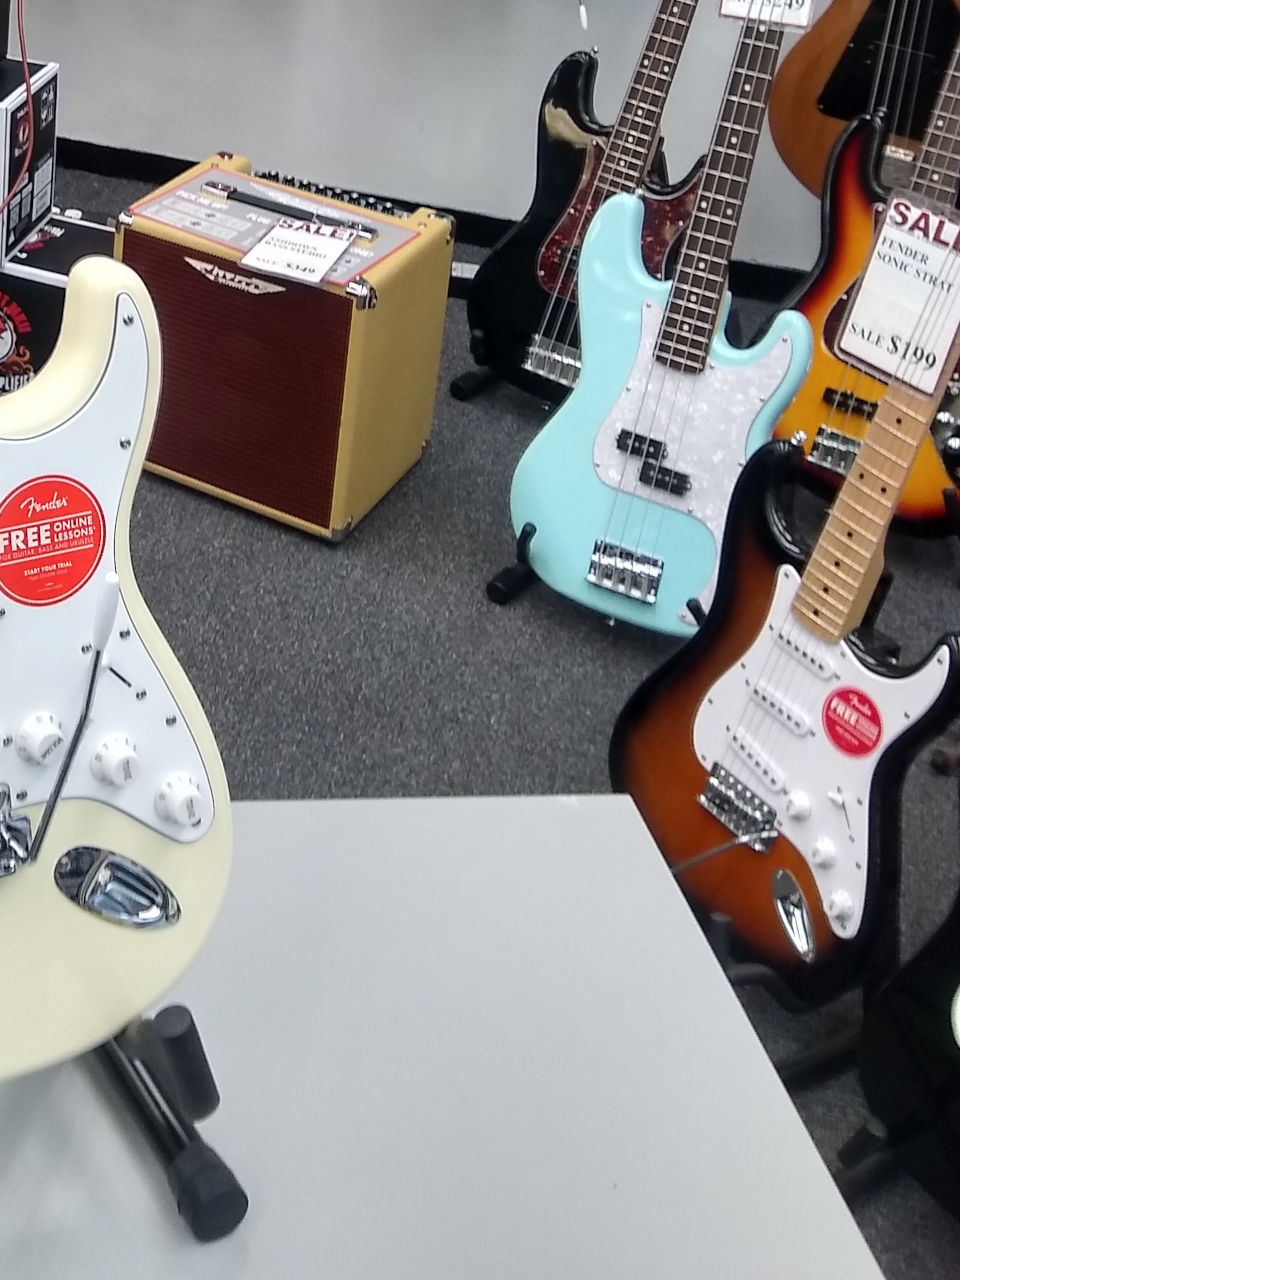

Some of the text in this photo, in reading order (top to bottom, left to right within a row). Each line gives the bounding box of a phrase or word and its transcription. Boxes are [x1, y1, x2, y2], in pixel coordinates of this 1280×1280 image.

[278, 218, 355, 242] SALE!
[880, 234, 930, 266] FENDER
[875, 252, 953, 295] SONIC STRAT
[848, 321, 938, 372] SALE $199
[20, 491, 67, 518] Fender
[53, 514, 93, 533] ONLINE
[53, 526, 94, 543] LESSONS
[37, 544, 54, 555] BASS
[54, 541, 69, 551] AND
[69, 536, 95, 548] UKULELE
[24, 567, 41, 577] START
[40, 563, 57, 572] YOUR
[57, 560, 73, 569] TRIAL
[829, 696, 859, 727] FREE
